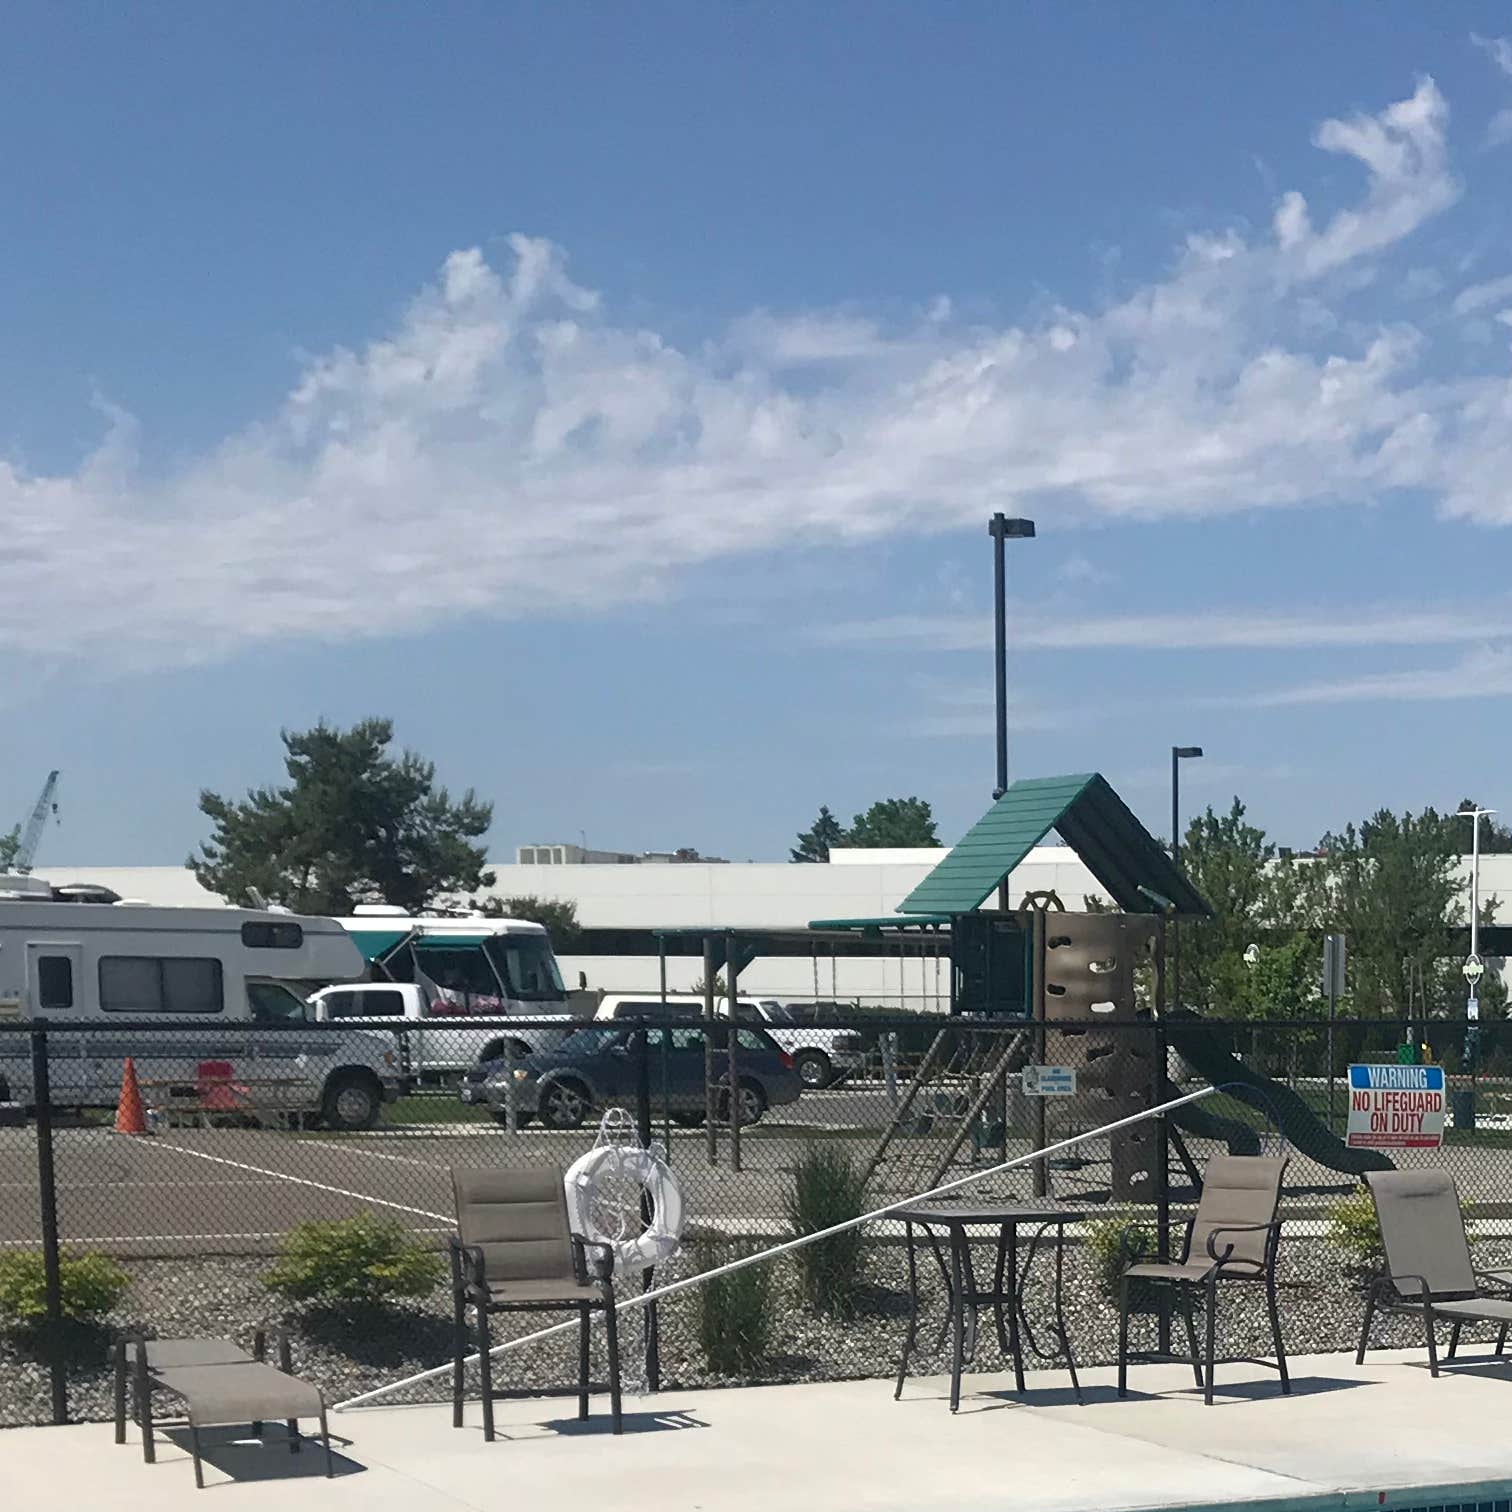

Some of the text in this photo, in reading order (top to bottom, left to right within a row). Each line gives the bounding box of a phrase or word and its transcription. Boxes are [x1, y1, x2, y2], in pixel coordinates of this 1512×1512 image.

[1367, 1067, 1428, 1088] WARNING
[1352, 1091, 1442, 1112] NO LIFEGUARD
[1370, 1113, 1424, 1132] ON DUTY
